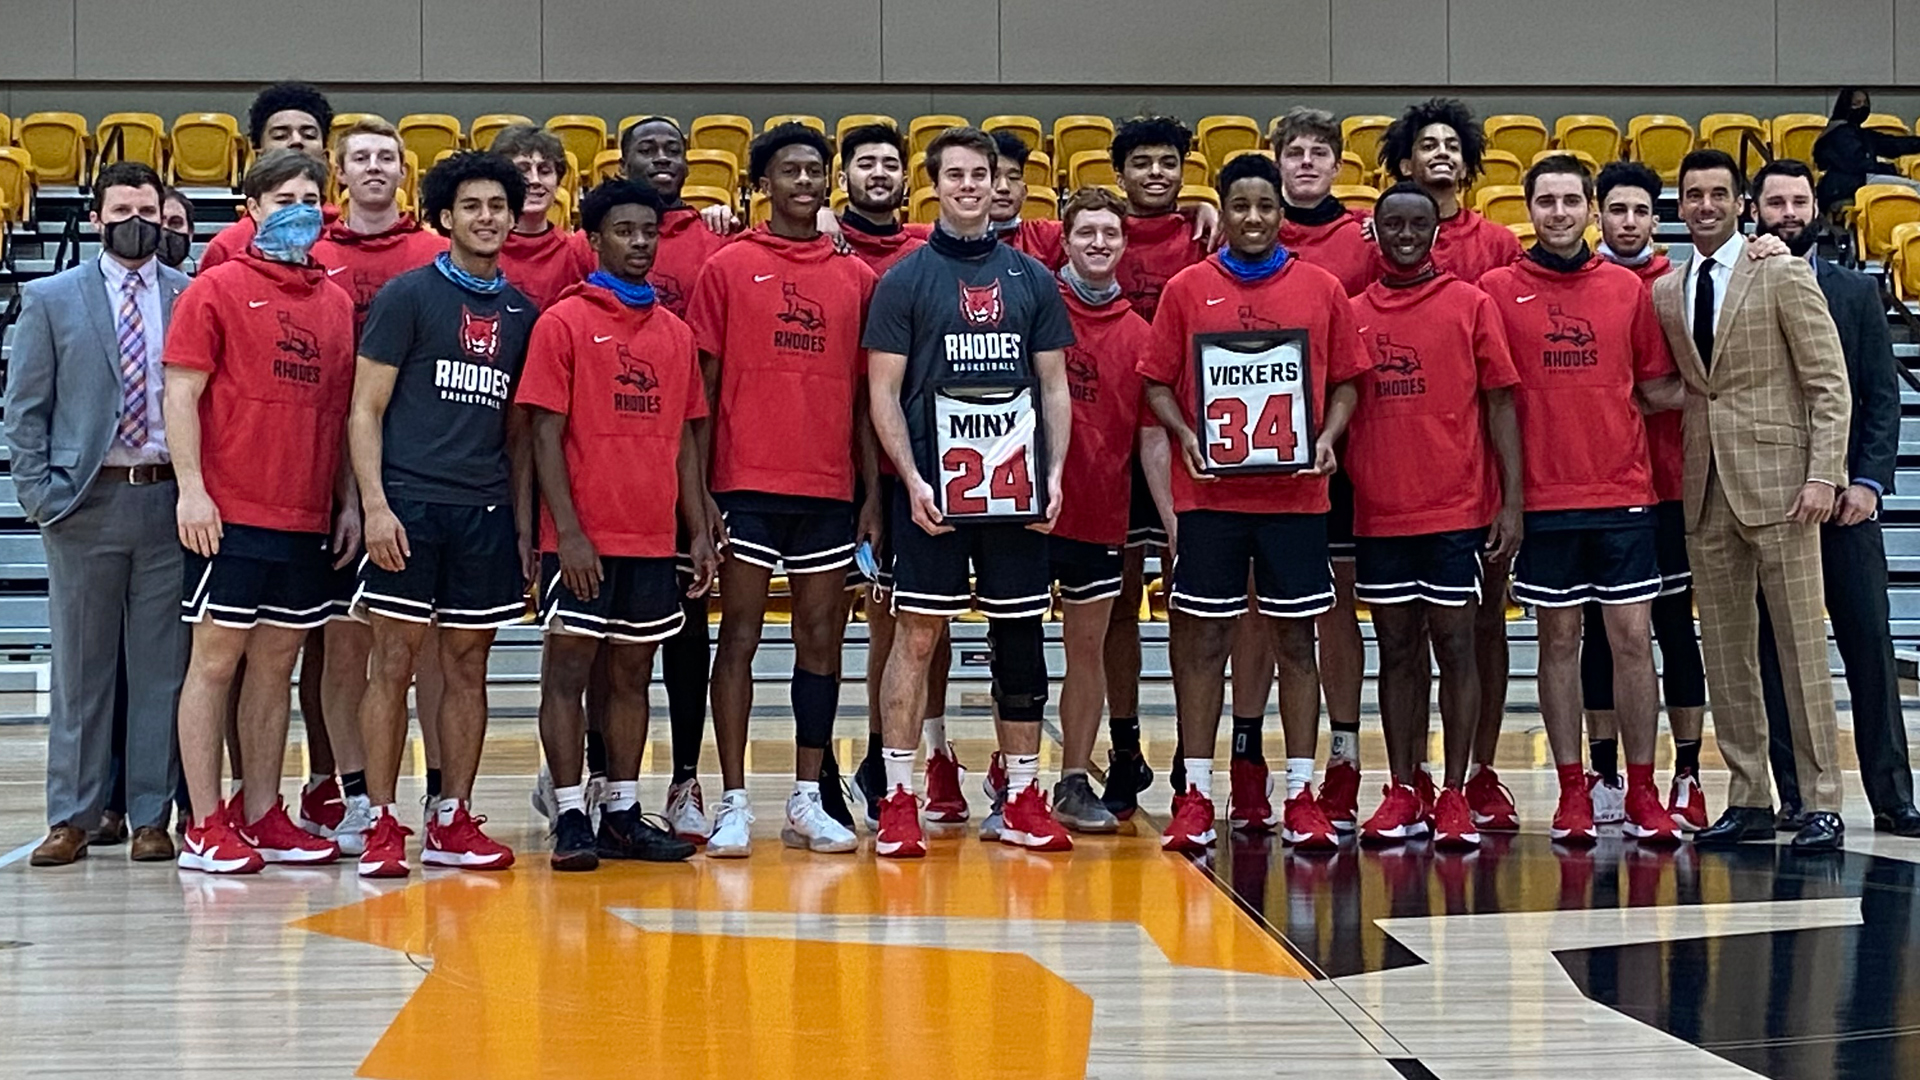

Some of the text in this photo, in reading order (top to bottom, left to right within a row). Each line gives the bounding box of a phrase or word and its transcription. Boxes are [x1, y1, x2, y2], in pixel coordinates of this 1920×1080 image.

[773, 331, 826, 353] RHODES
[944, 333, 1021, 361] RHODES
[953, 362, 1015, 371] BASKETBALL
[1543, 350, 1598, 367] RHODES
[273, 359, 320, 383] RHODES
[435, 359, 510, 400] RHODES
[1209, 362, 1298, 386] VICKERS
[1374, 377, 1426, 398] RHODES
[948, 410, 1018, 439] MINX
[1207, 393, 1298, 465] 34
[942, 444, 1033, 515] 24
